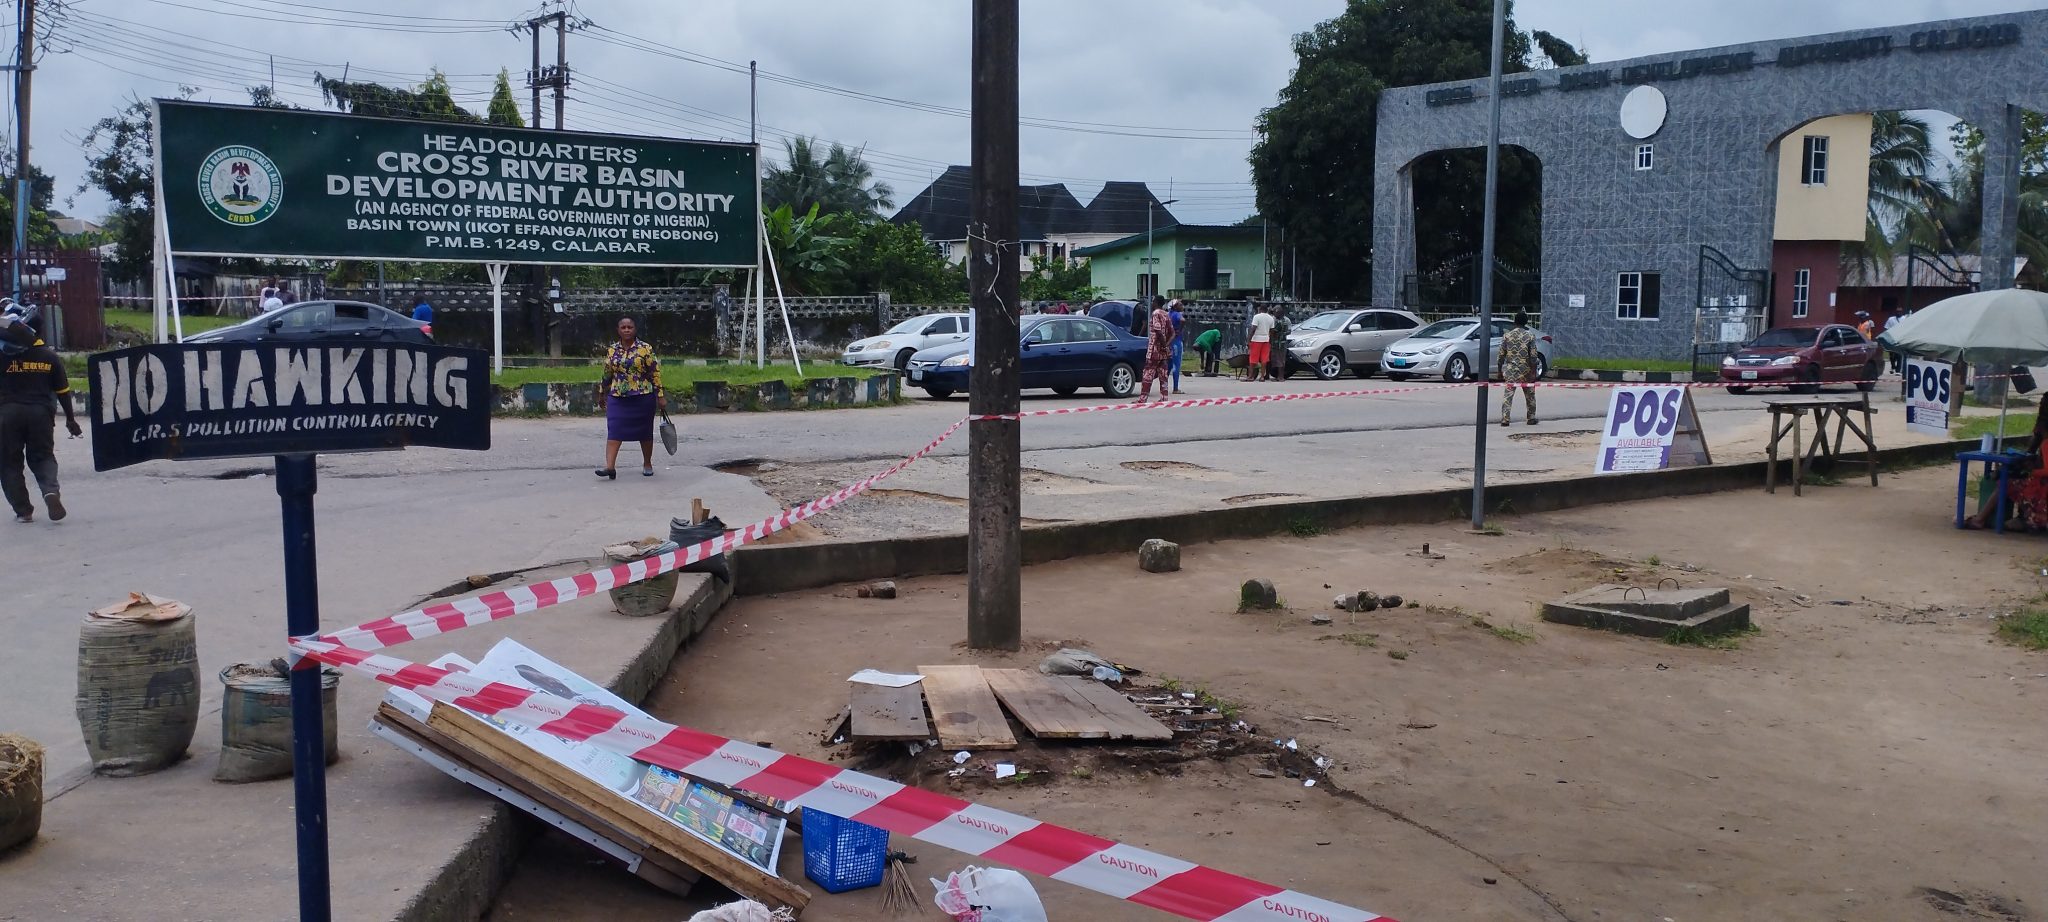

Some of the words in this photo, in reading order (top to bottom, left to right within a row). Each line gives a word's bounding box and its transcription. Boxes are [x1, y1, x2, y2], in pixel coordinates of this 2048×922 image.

[229, 148, 274, 173] DEVELOPMENT
[423, 133, 638, 164] HEADQUARTERS
[376, 151, 490, 177] CROSS
[500, 158, 589, 184] RIVER
[597, 165, 685, 189] BASIN
[326, 174, 565, 205] DEVELOPMENT
[572, 187, 735, 213] AUTHORITY
[355, 199, 385, 215] (AN
[389, 202, 449, 217] AGENCY
[452, 204, 472, 218] OF
[476, 205, 536, 220] FEDERAL
[537, 208, 631, 226] GOVERNMENT
[632, 214, 651, 226] OF
[654, 214, 710, 229] NIGERIA)
[346, 218, 402, 231] BASIN
[406, 220, 461, 232] TOWN
[465, 220, 511, 234] (IKOT
[515, 224, 628, 240] EFFANGA/IKOT
[632, 228, 719, 243] ENEOBONG)
[425, 236, 491, 249] P.M.B.
[494, 238, 546, 252] 1249,
[551, 240, 656, 254] CALABAR.
[97, 352, 168, 425] NO
[182, 347, 468, 412] HAWKING
[1907, 364, 1951, 404] POS
[1609, 388, 1681, 437] POS
[186, 417, 287, 438] POLLUTION
[1616, 437, 1663, 447] AVAILABLE
[619, 725, 656, 741] CAUTION
[719, 751, 762, 769] CAUTION
[831, 780, 878, 800] CAUTION
[957, 814, 1009, 836] CAUTION
[1099, 853, 1158, 879] CAUTION
[1262, 899, 1330, 922] CAUTION
